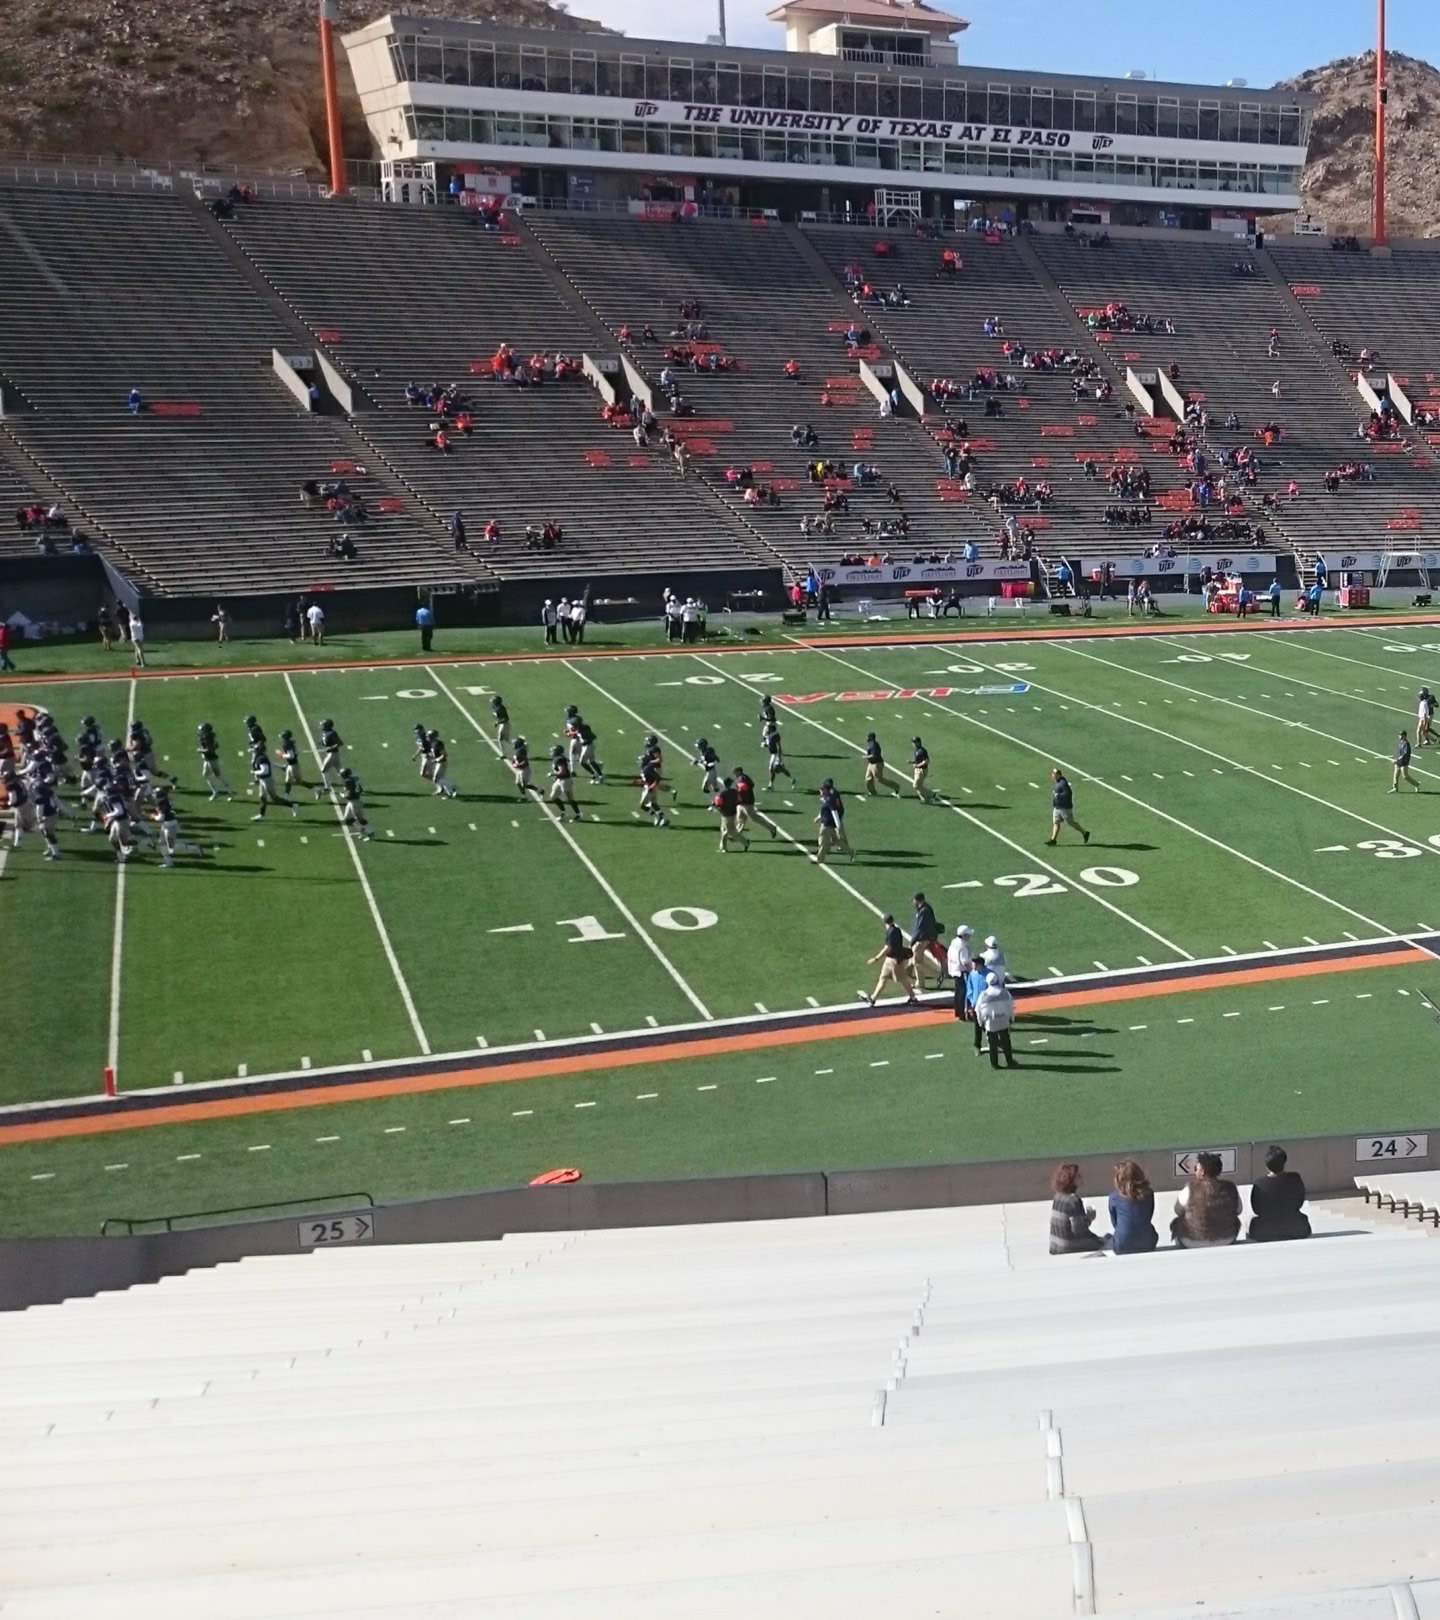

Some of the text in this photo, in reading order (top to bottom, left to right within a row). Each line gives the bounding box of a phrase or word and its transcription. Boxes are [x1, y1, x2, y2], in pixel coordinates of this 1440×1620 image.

[634, 101, 659, 118] UTEP
[683, 105, 1071, 148] THE UNIVERSITY OF TEXAS AT EL PASO
[1091, 135, 1114, 151] UTEP
[685, 672, 783, 684] 20
[397, 685, 494, 699] 10
[993, 866, 1140, 897] 20
[556, 906, 719, 943] 10
[1371, 1139, 1397, 1157] 24
[311, 1220, 344, 1243] 25
